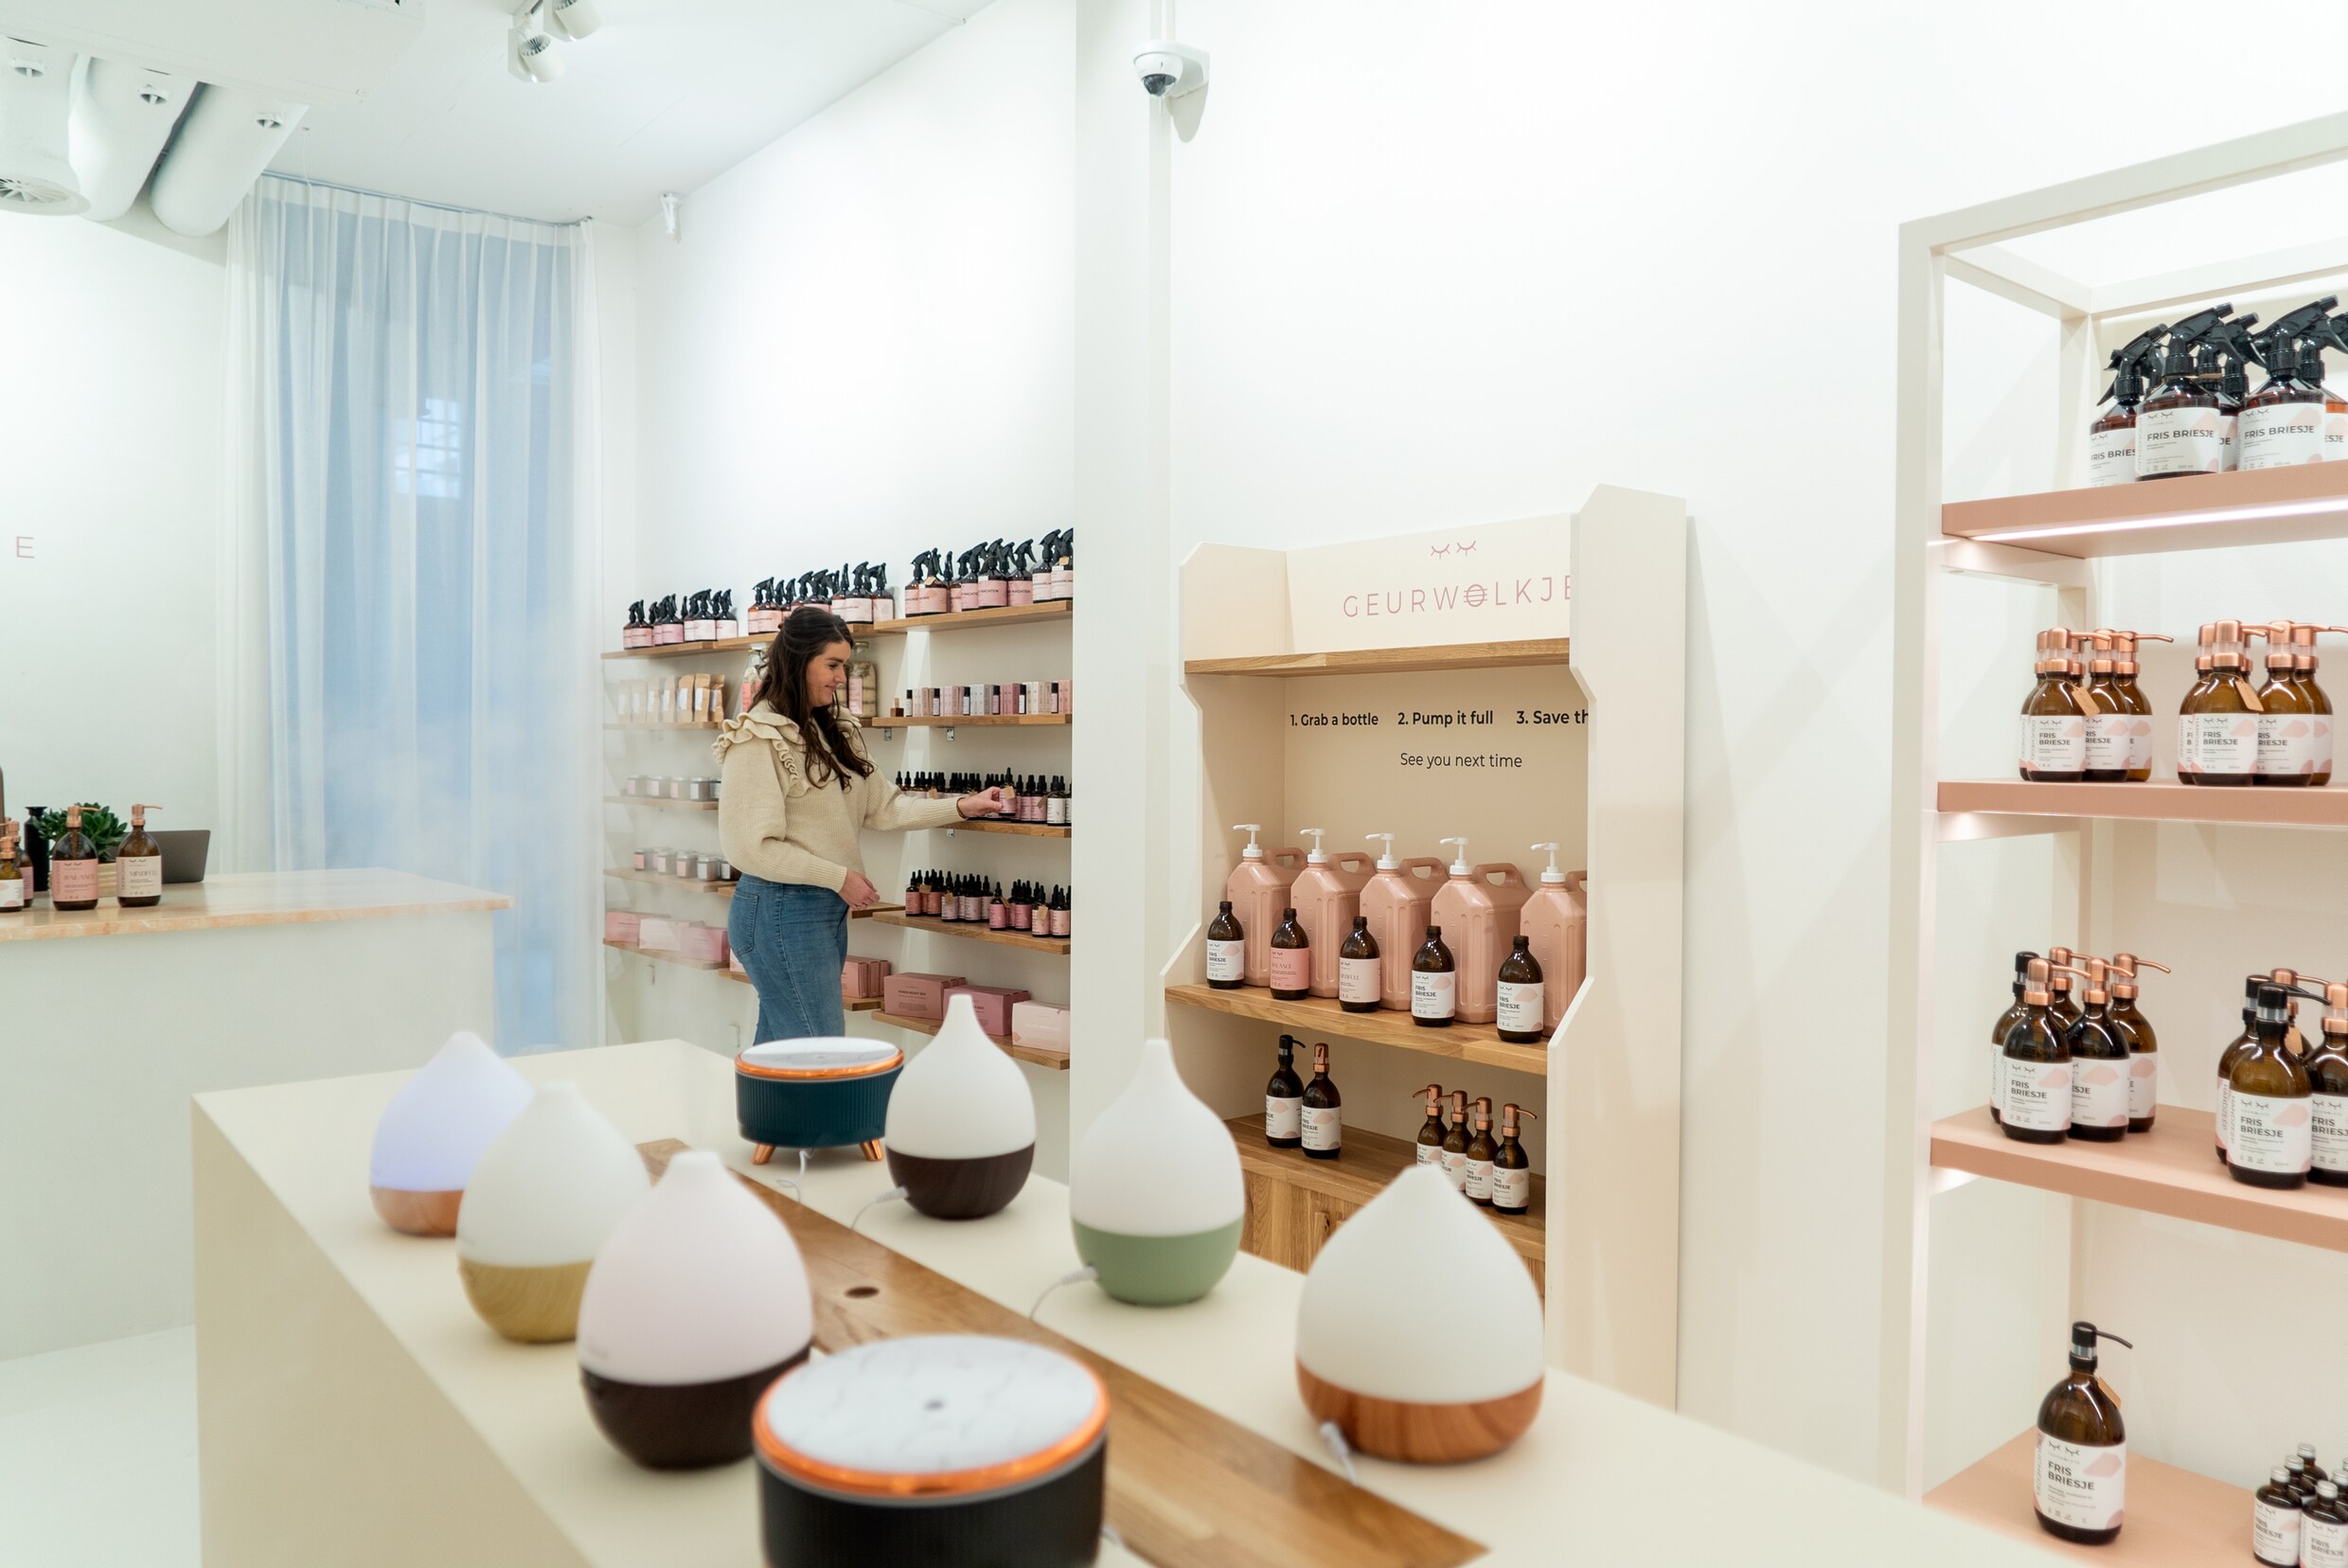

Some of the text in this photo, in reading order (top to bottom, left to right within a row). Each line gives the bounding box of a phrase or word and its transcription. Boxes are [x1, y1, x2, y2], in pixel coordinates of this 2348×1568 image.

[2146, 429, 2215, 441] FRIS BRIESJE
[2244, 425, 2315, 439] FRIS BRIESJE
[1290, 714, 1298, 726] 1.
[1300, 713, 1327, 726] Grab
[1331, 716, 1339, 726] a
[1342, 712, 1379, 726] bottle
[1397, 712, 1409, 725] 2.
[1413, 712, 1453, 728] Pump
[1457, 711, 1467, 725] it
[1470, 711, 1494, 725] full
[1516, 711, 1529, 725] 3.
[1533, 710, 1570, 724] Save
[1400, 752, 1522, 770] See you next time
[2011, 1079, 2030, 1089] FRIS
[2011, 1088, 2047, 1099] BRIESJE
[2240, 1116, 2263, 1127] FRIS
[2312, 1115, 2335, 1127] FRIS
[2240, 1125, 2284, 1138] BRIESJE
[2048, 1461, 2072, 1477] FRIS
[2048, 1470, 2095, 1490] BRIESJE
